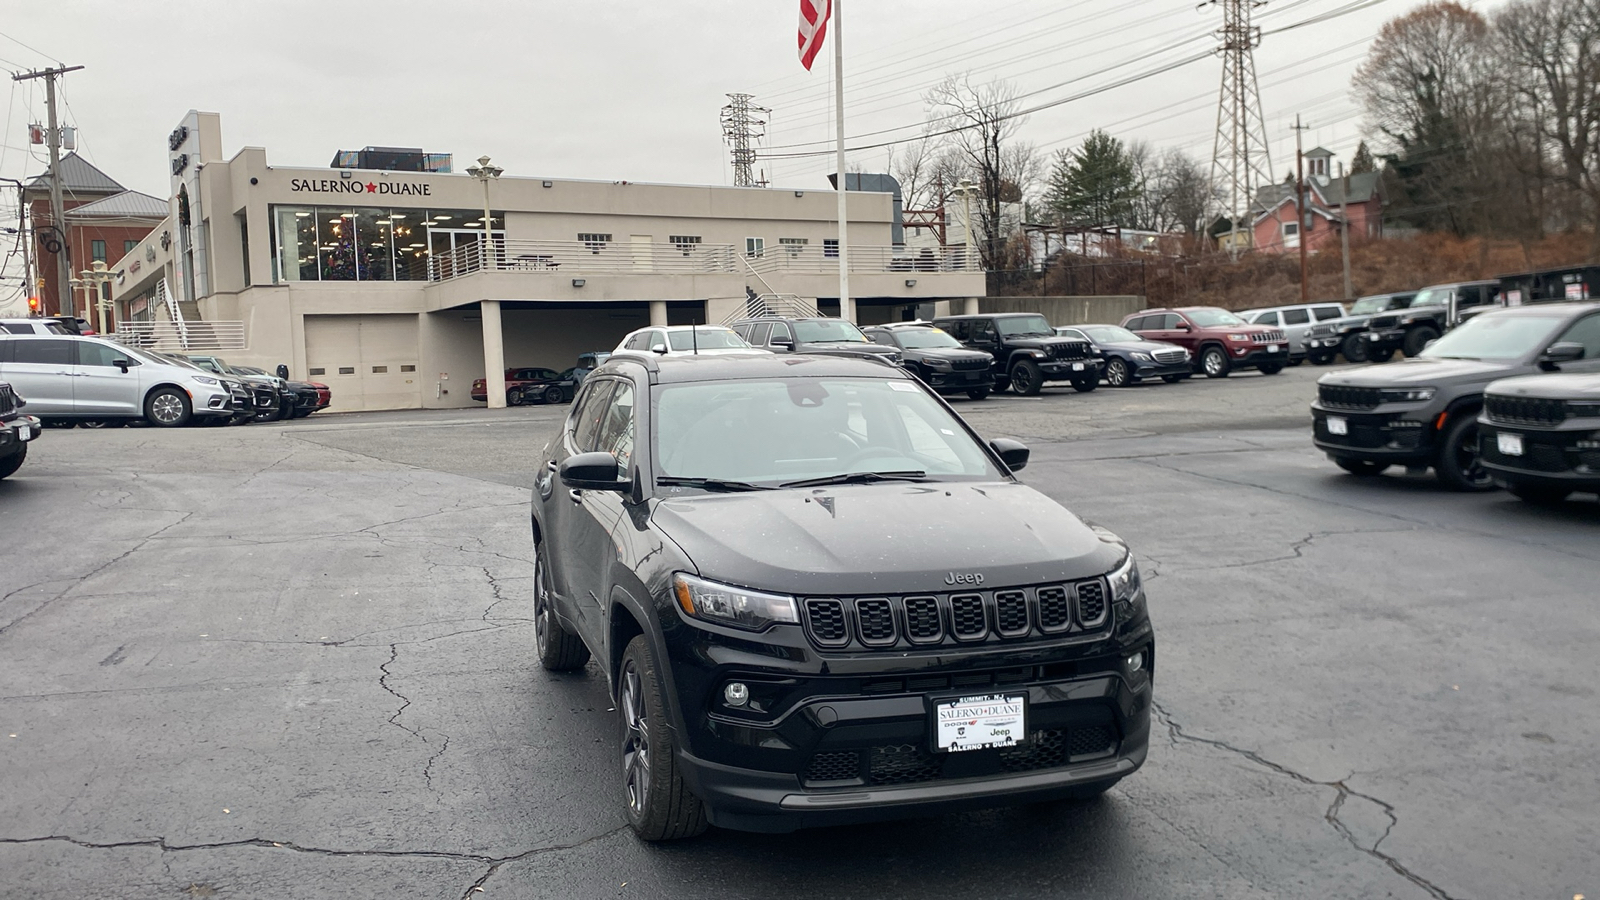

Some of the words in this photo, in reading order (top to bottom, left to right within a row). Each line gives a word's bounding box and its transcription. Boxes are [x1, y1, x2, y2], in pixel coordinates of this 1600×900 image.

[291, 179, 364, 194] SALERNO
[379, 182, 432, 196] DUANE
[944, 571, 985, 586] Jeep
[940, 708, 983, 719] SALERNO
[988, 705, 1021, 715] DUANE
[948, 744, 982, 752] SALERNO
[993, 740, 1017, 748] DUANE
